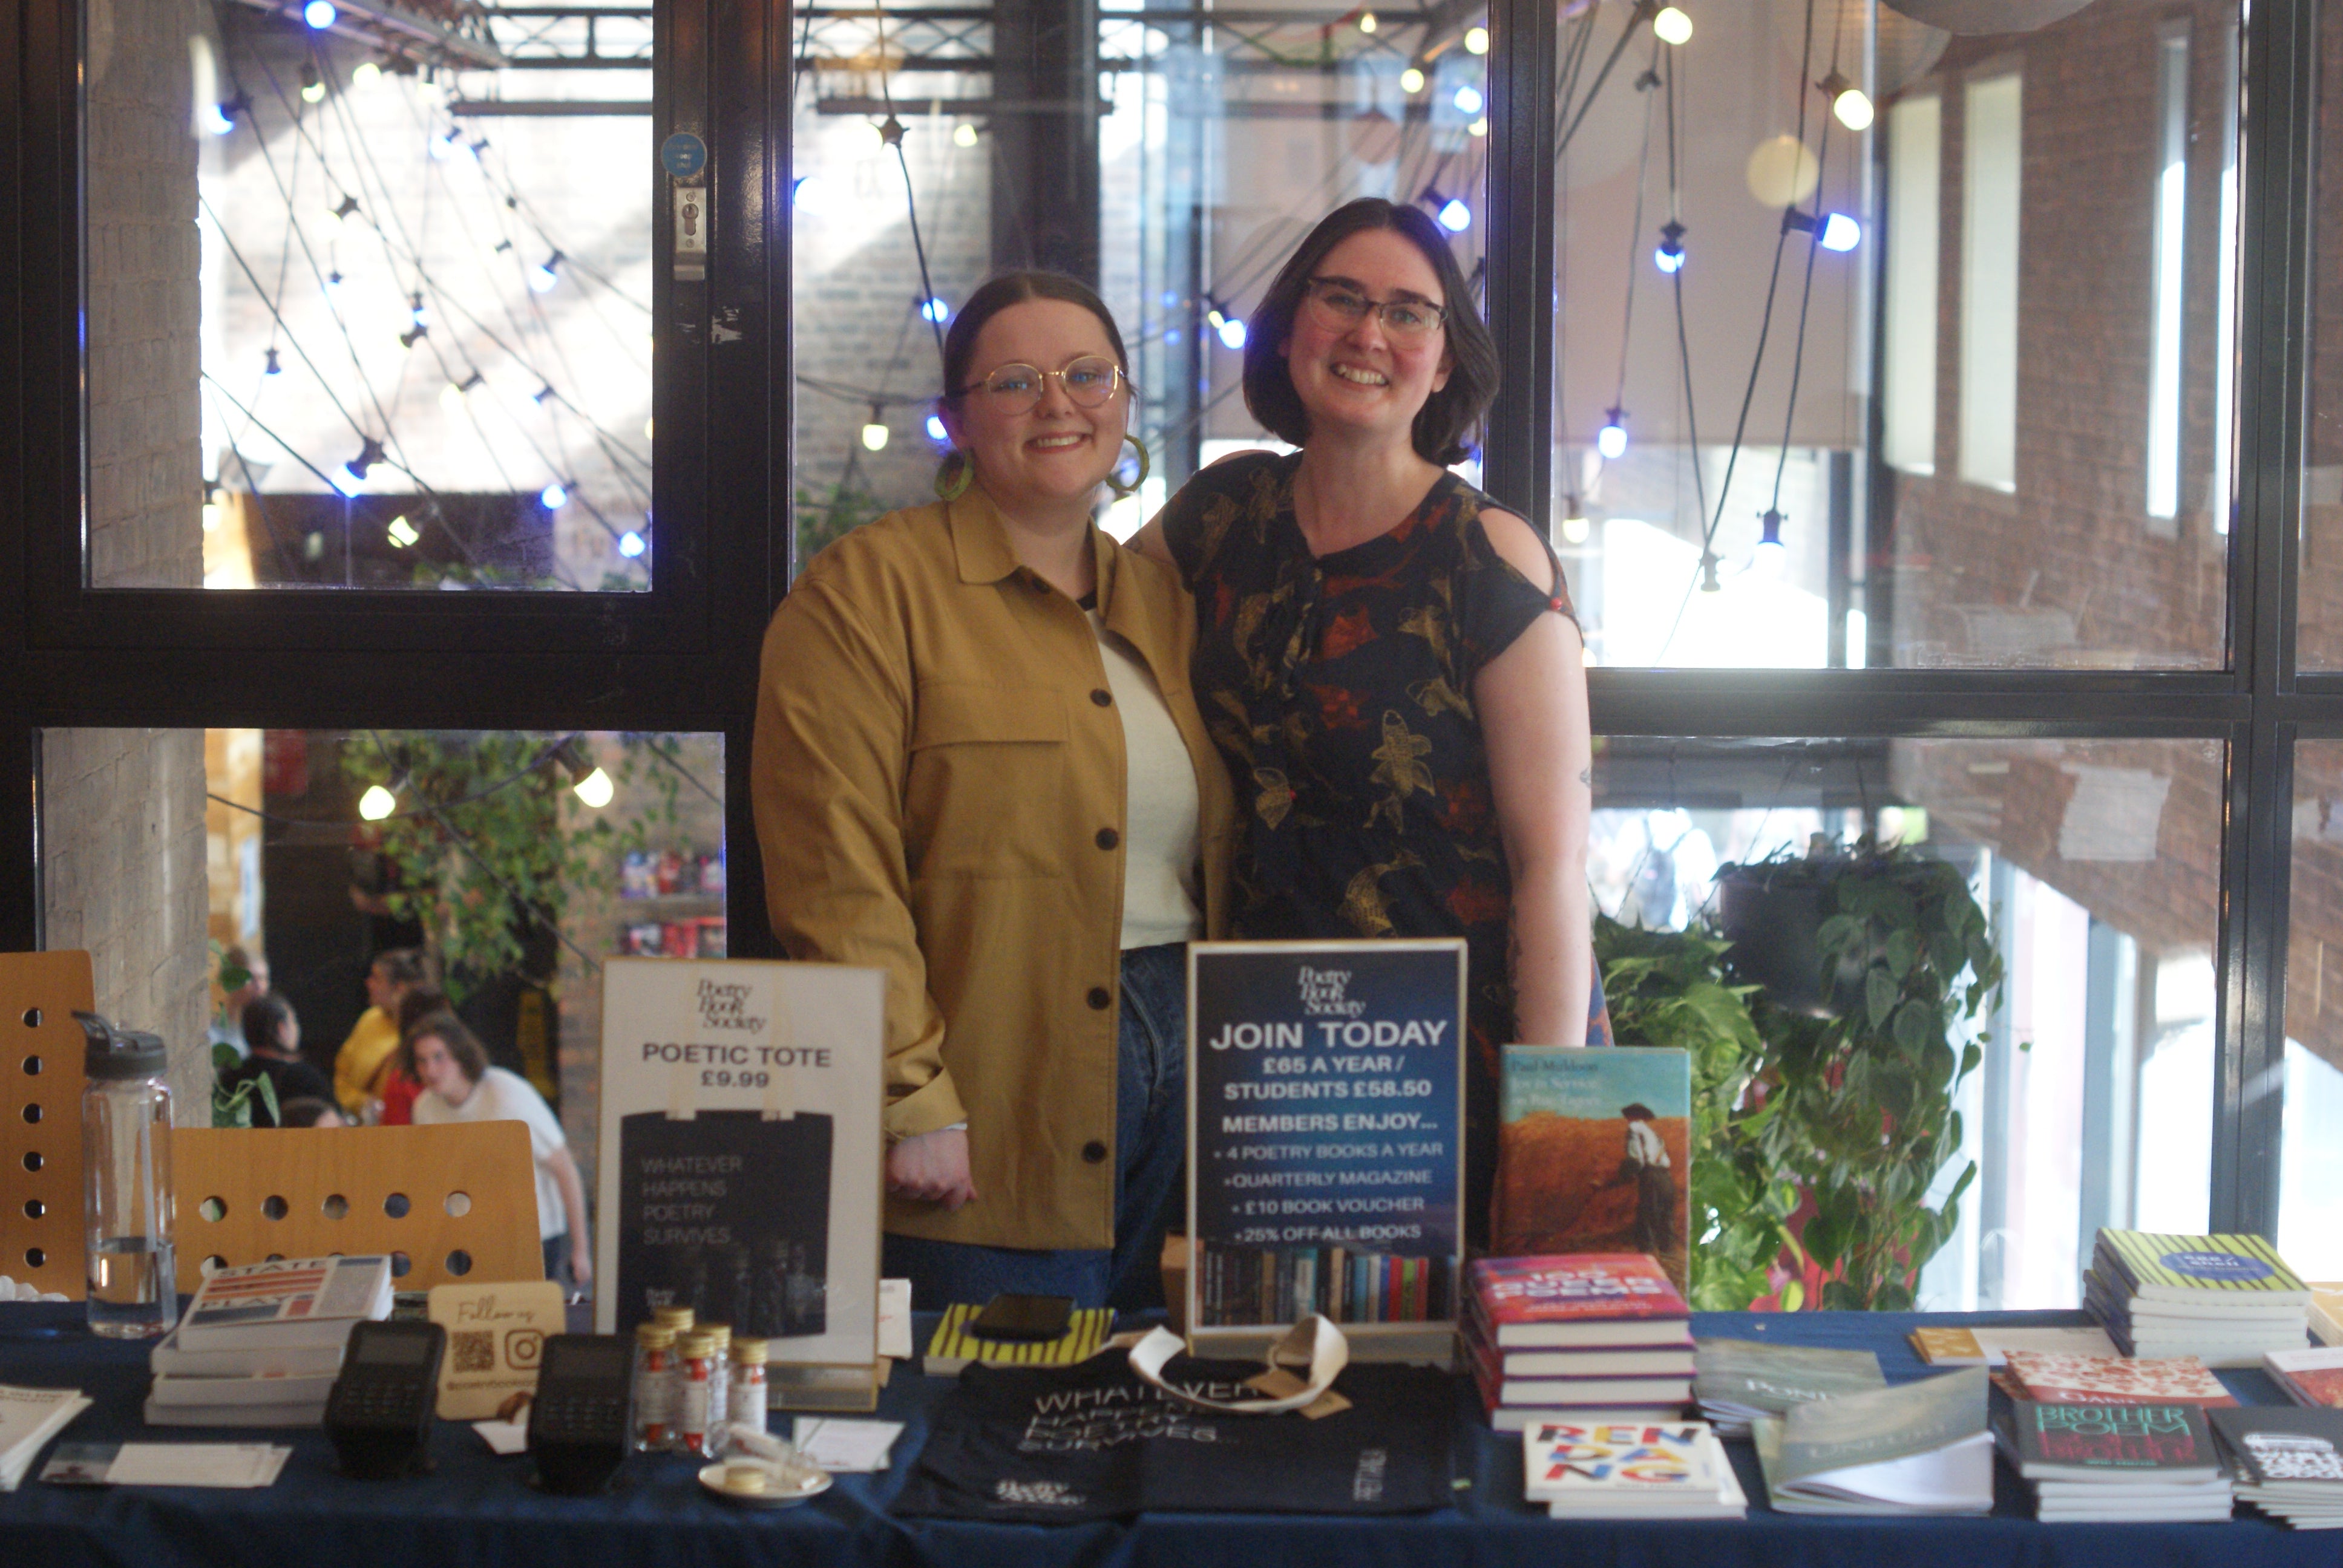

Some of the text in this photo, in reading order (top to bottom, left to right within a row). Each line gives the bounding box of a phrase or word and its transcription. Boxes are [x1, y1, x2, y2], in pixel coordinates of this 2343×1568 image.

[1210, 1019, 1447, 1050] JOIN TODAY
[642, 1042, 832, 1068] POETIC TOTE
[1262, 1056, 1306, 1074] £65
[1311, 1056, 1328, 1073] A
[701, 1070, 769, 1088] £9.99
[1224, 1079, 1432, 1100] STUDENTS £58.50
[1222, 1114, 1339, 1133] MEMBERS
[1241, 1145, 1314, 1160] POETRY
[1316, 1142, 1377, 1159] BOOKS
[1380, 1142, 1395, 1157] A
[1397, 1141, 1443, 1157] YEAR
[641, 1155, 743, 1173] WHATEVER
[1339, 1169, 1432, 1186] MAGAZINE
[643, 1180, 727, 1197] HAPPENS
[644, 1204, 716, 1221] POETRY
[1282, 1199, 1333, 1215] BOOK
[1335, 1195, 1425, 1214] VOUCHER
[1282, 1226, 1320, 1242] OFF
[1321, 1224, 1353, 1241] ALL
[1358, 1223, 1421, 1241] BOOKS
[2036, 1405, 2185, 1423] BROTHER
